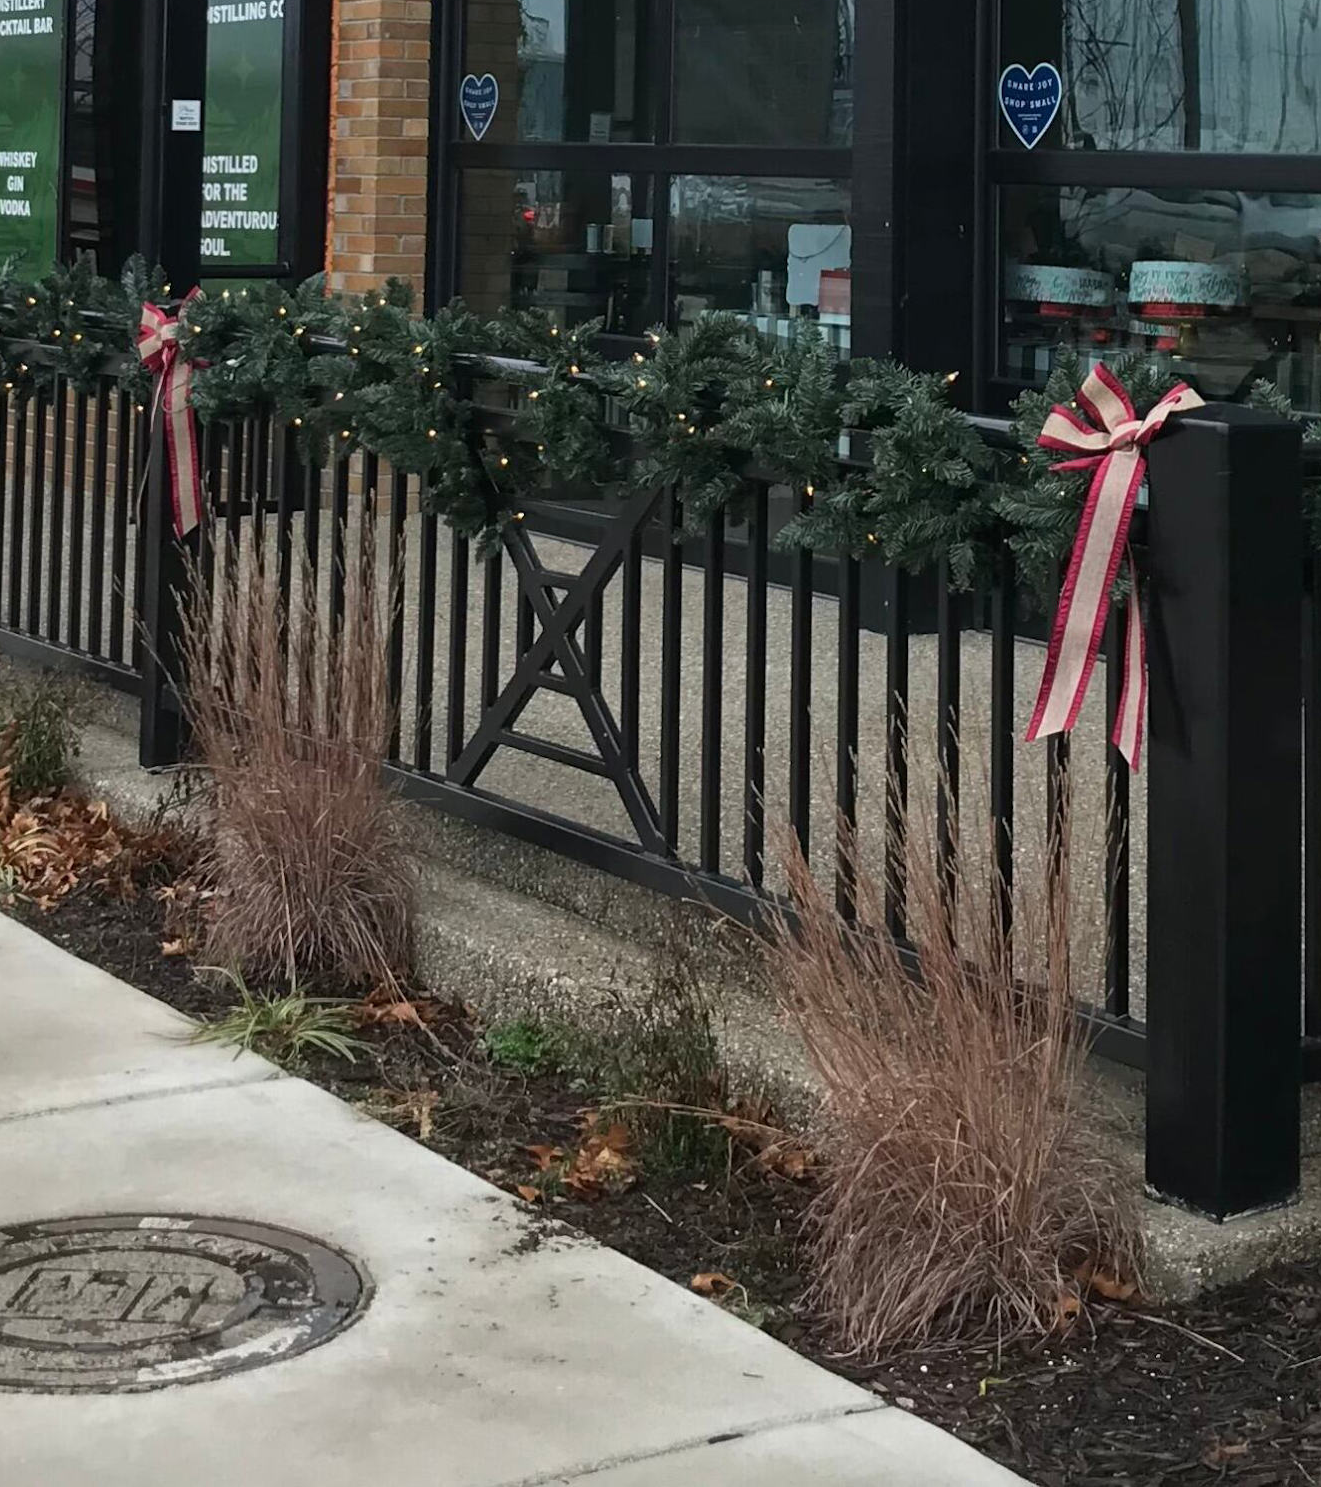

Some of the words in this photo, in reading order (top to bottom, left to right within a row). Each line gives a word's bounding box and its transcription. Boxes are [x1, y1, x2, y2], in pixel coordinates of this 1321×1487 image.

[207, 1, 267, 24] ISTILLING
[34, 17, 54, 34] BAR
[1007, 79, 1034, 91] SHARE
[1038, 78, 1053, 90] JOY
[1004, 97, 1026, 108] SHOP
[1030, 95, 1056, 109] SMALL
[7, 176, 24, 192] GIN
[223, 183, 248, 202] THE
[0, 199, 30, 216] VODKA
